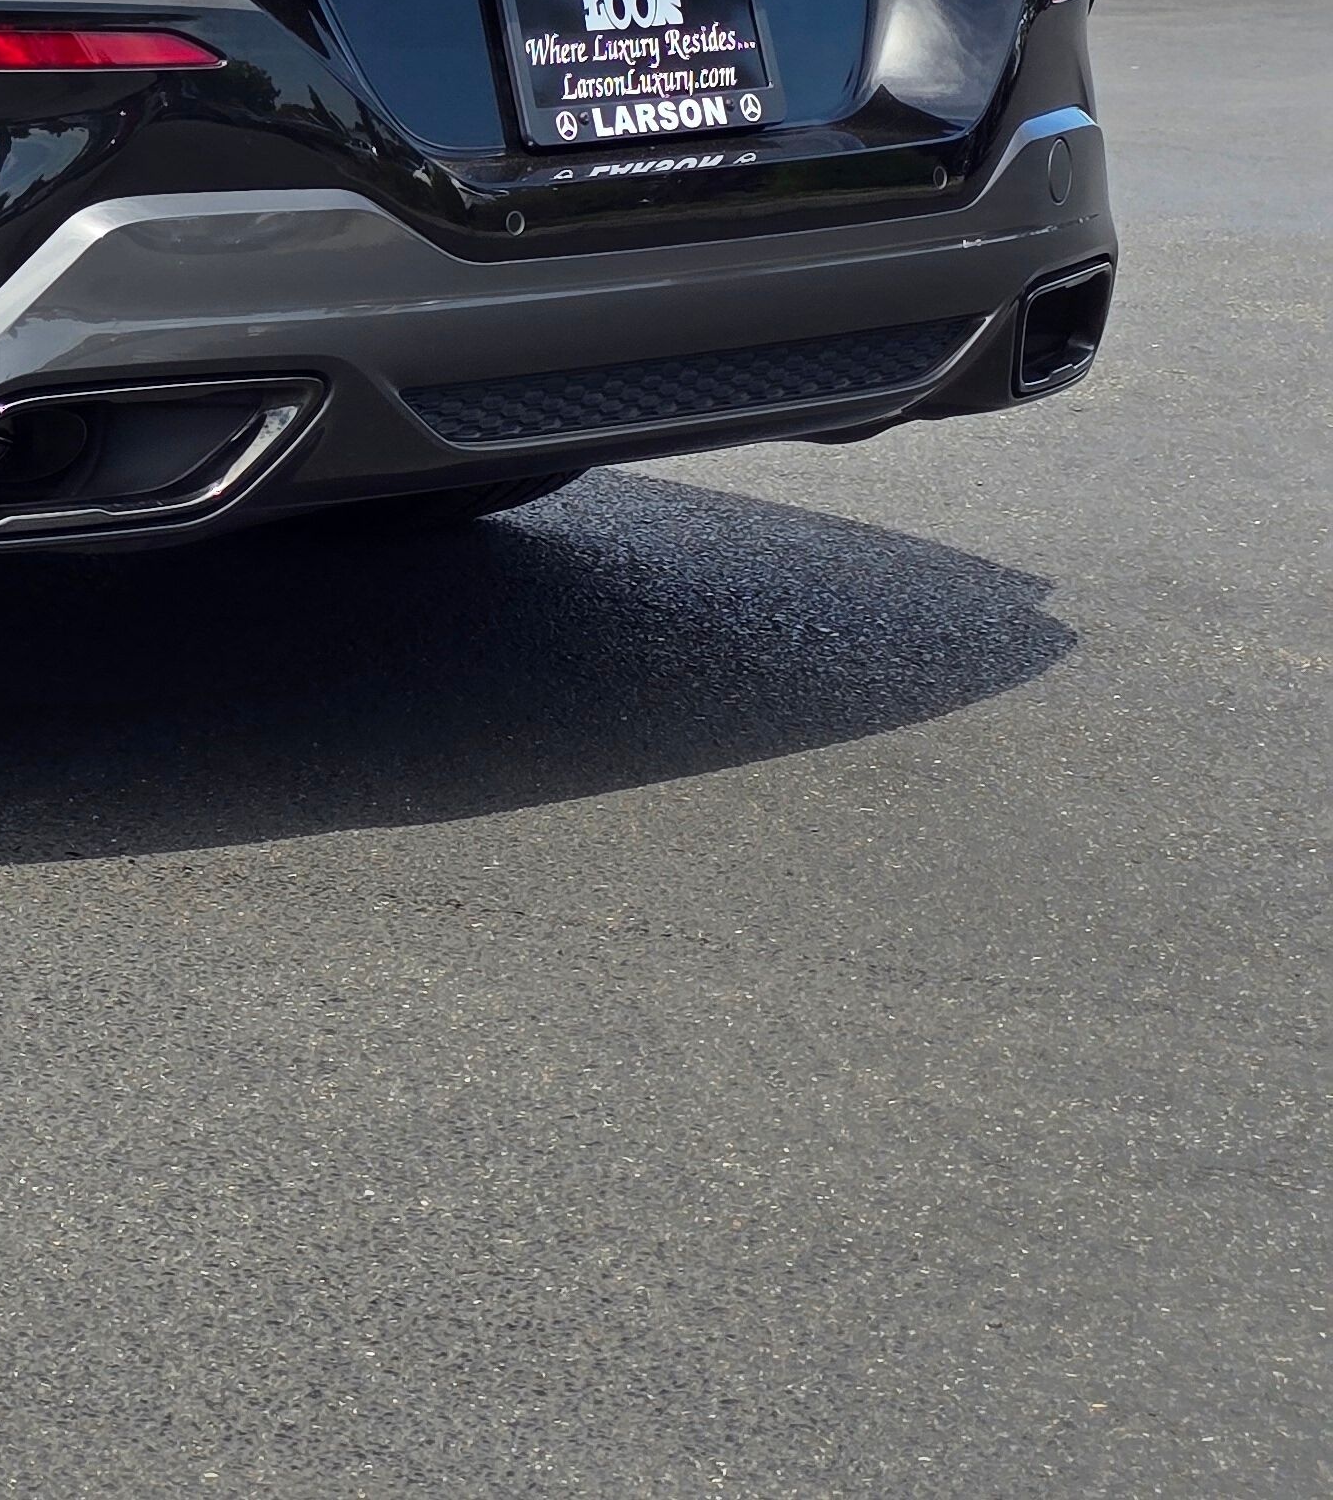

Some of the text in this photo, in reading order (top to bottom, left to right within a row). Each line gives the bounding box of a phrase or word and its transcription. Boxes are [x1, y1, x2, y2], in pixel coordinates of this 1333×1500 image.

[525, 21, 756, 68] Where Luxury Resides...
[561, 66, 737, 99] LarsonLuxury.com
[592, 96, 728, 137] LARSON
